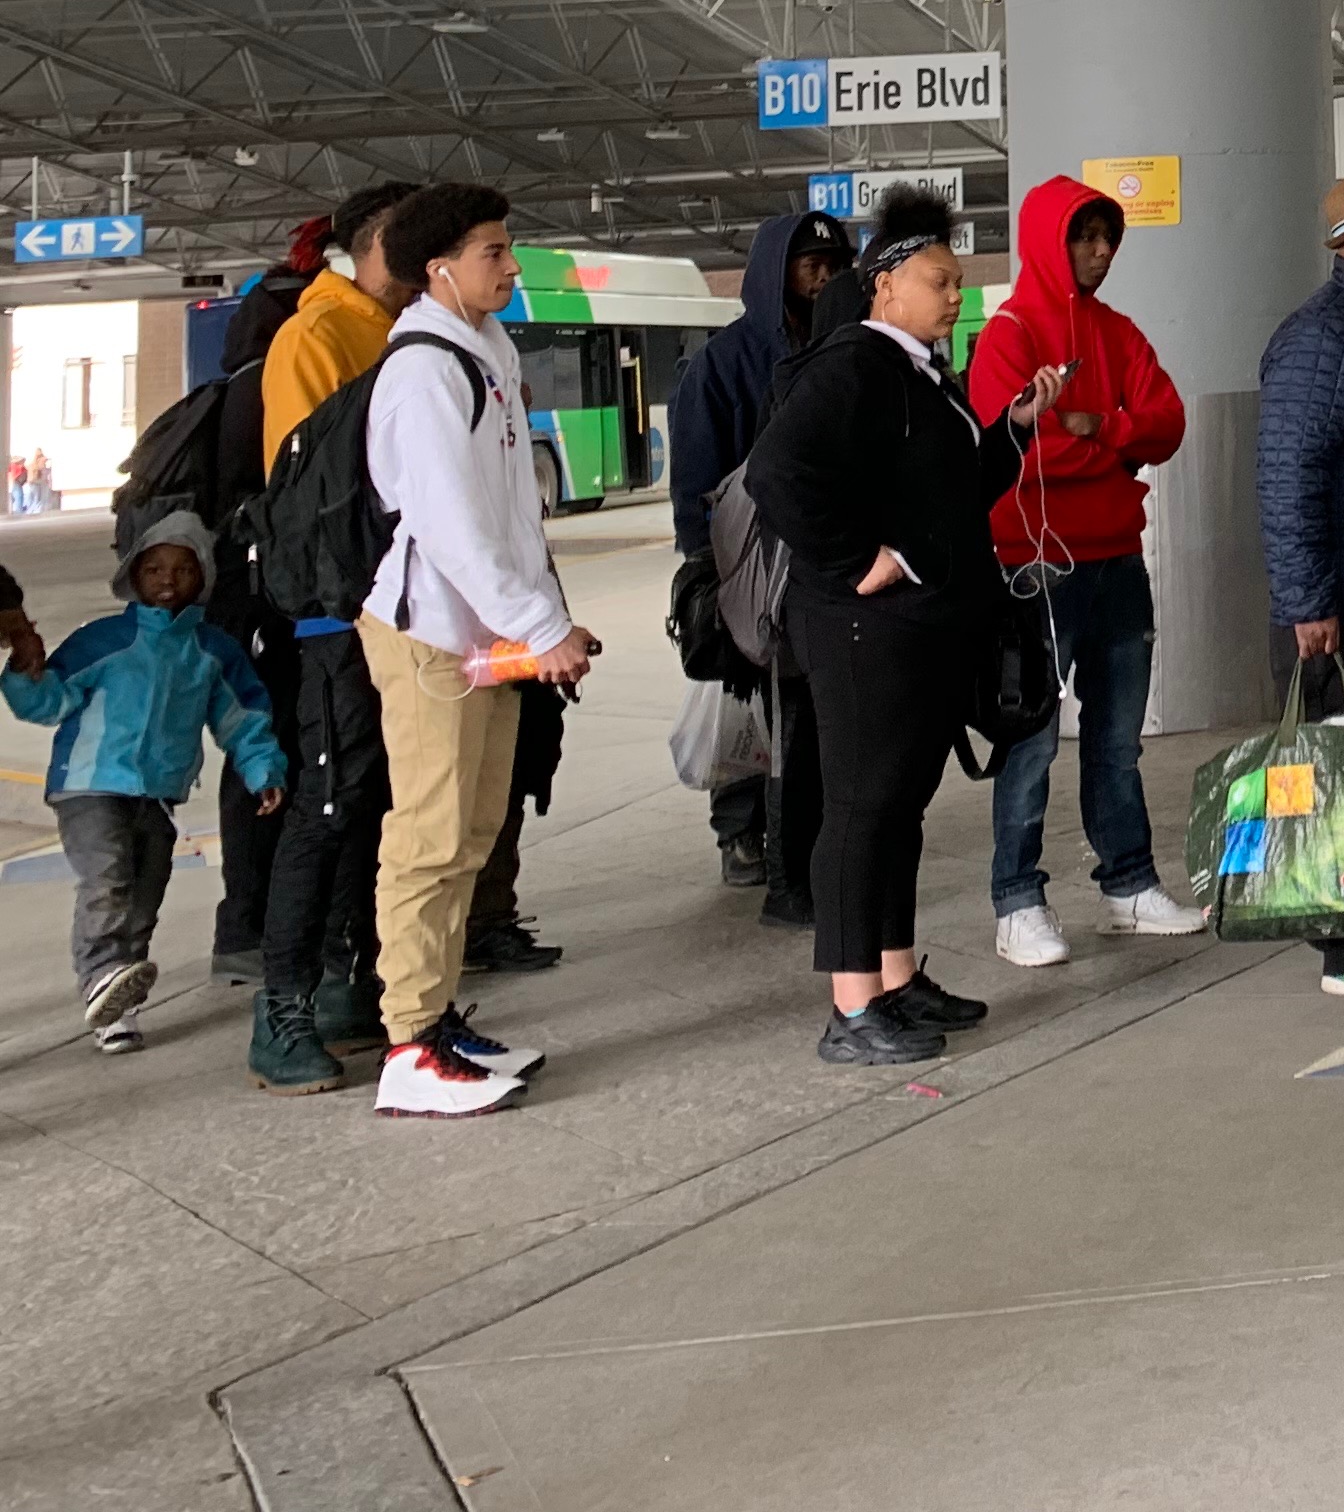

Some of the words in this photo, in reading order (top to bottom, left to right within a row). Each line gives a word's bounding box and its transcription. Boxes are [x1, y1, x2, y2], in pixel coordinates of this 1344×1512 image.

[764, 72, 822, 117] B10
[835, 69, 902, 113] Erie
[916, 65, 990, 109] Blvd
[813, 181, 850, 211] B11
